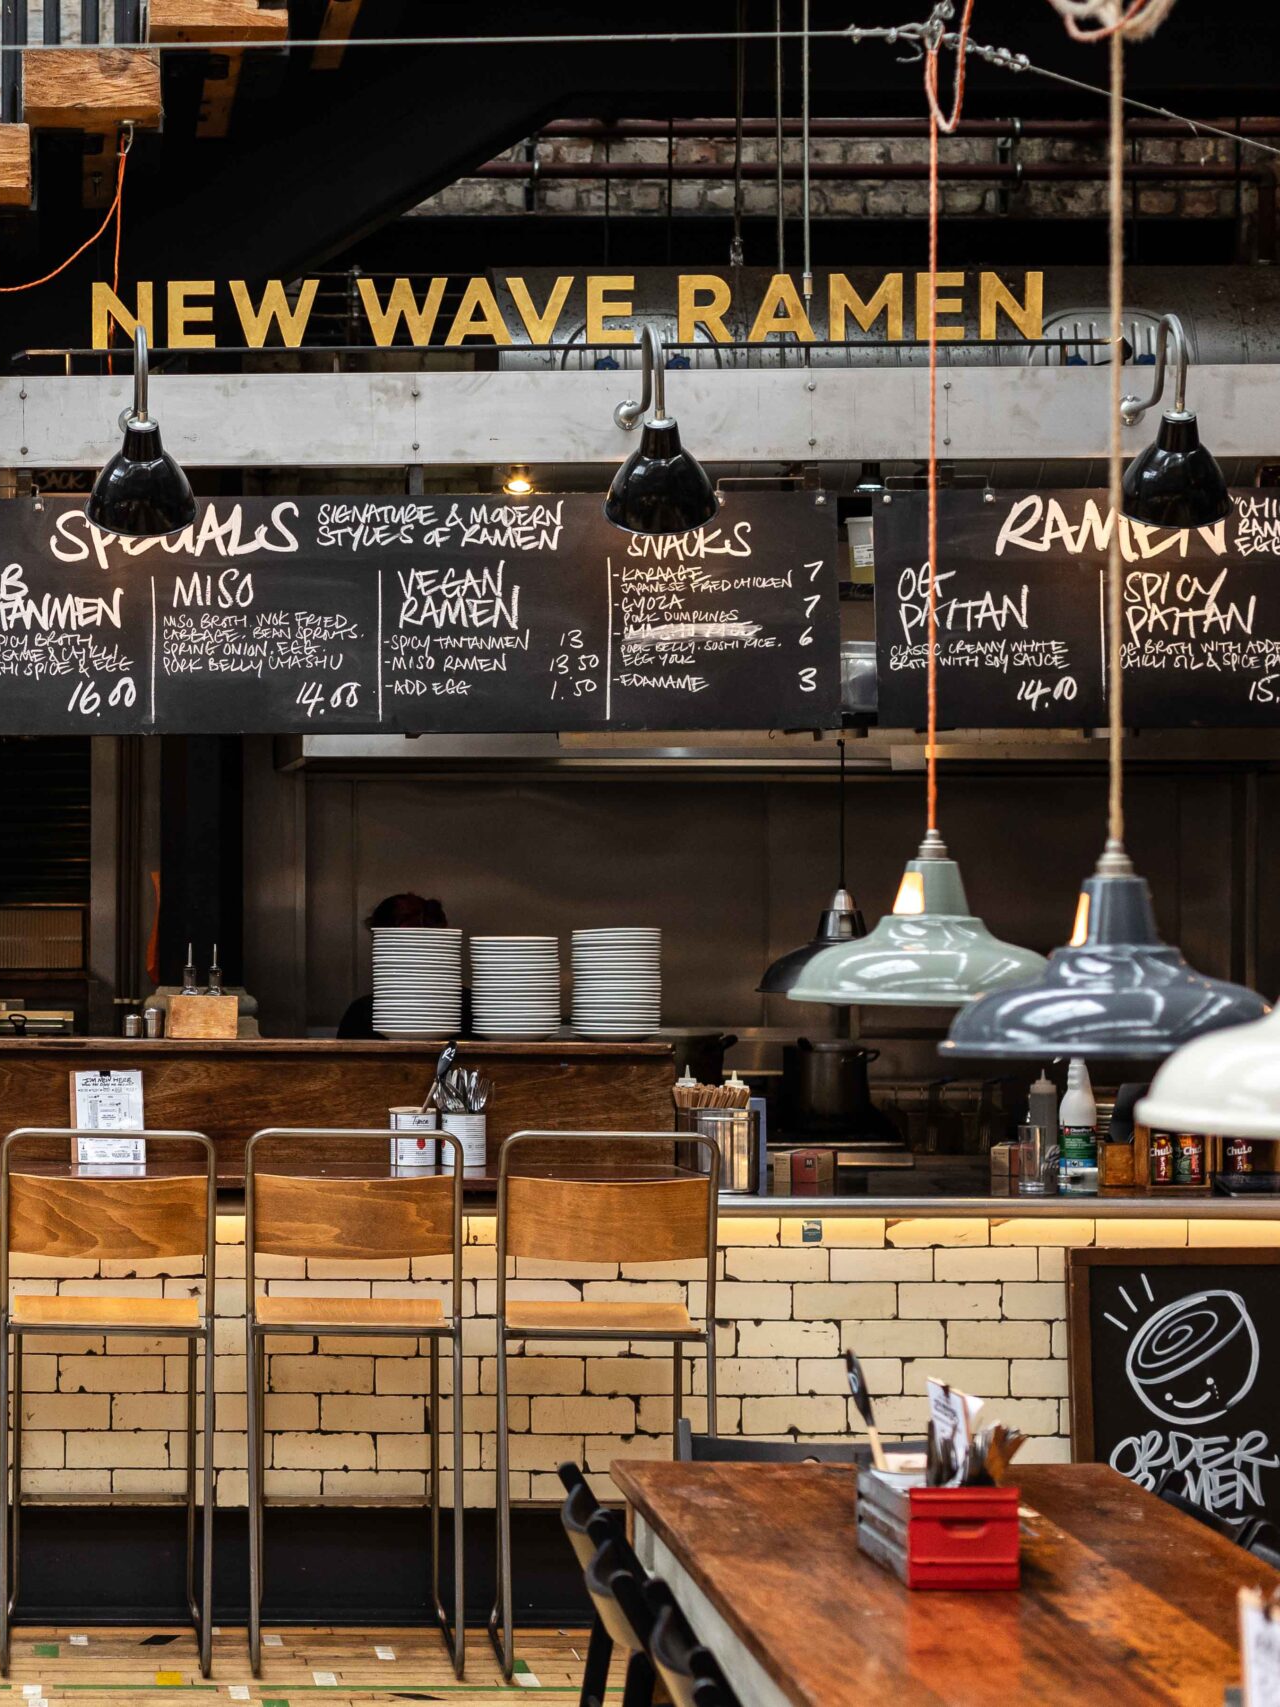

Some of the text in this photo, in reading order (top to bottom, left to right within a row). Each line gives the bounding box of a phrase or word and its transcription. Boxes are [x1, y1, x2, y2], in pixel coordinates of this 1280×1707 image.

[91, 271, 1044, 349] NEW WAVE RAMEN
[317, 500, 563, 531] SIGNATURE & MODERN
[995, 493, 1228, 563] RAMEN
[317, 525, 562, 551] STYLES OF RAMEN
[626, 521, 753, 562] SNACKS
[397, 560, 507, 600] VEGAN
[620, 568, 794, 597] JAPANESE FRIED CHICKEN
[803, 560, 824, 583] 7
[173, 568, 255, 609] MISO
[1123, 567, 1229, 609] SPICY
[398, 585, 522, 630] RAMEN
[623, 609, 740, 627] PORK DUMPLINGS
[803, 593, 822, 619] 7
[898, 584, 1030, 646] PAITAN
[163, 614, 194, 629] MISO
[256, 610, 291, 627] WOK
[295, 611, 349, 630] FRIED
[1125, 595, 1257, 648] PAITAN
[252, 627, 292, 640] BEAN
[433, 628, 531, 651] TANTANMEN
[560, 629, 585, 650] 13
[798, 626, 815, 648] 6
[48, 648, 57, 663] &
[163, 641, 222, 659] SPRING
[622, 652, 657, 667] EGG
[890, 638, 1070, 658] CLASSC CREAMY WHITE
[1144, 638, 1195, 657] BROTH
[1200, 640, 1242, 654] WITH
[23, 661, 75, 681] SPICE
[78, 660, 90, 679] &
[92, 655, 135, 675] EGG
[163, 653, 345, 679] PORK BELLY CHASHU
[443, 653, 508, 673] RAMEN
[939, 655, 980, 668] WITH
[984, 653, 1010, 675] SOY
[1012, 652, 1071, 670] SAUCE
[1120, 654, 1167, 669] CHILLI
[1173, 654, 1205, 671] OIL
[1206, 651, 1222, 672] &
[1222, 652, 1262, 672] SPICE
[431, 678, 473, 697] EGG
[798, 667, 818, 692] 3
[66, 676, 138, 718] 16.00
[295, 681, 362, 718] 14.00
[1016, 676, 1078, 712] 14.00
[1110, 1430, 1280, 1479] ORDER
[1131, 1462, 1266, 1513] MEN
